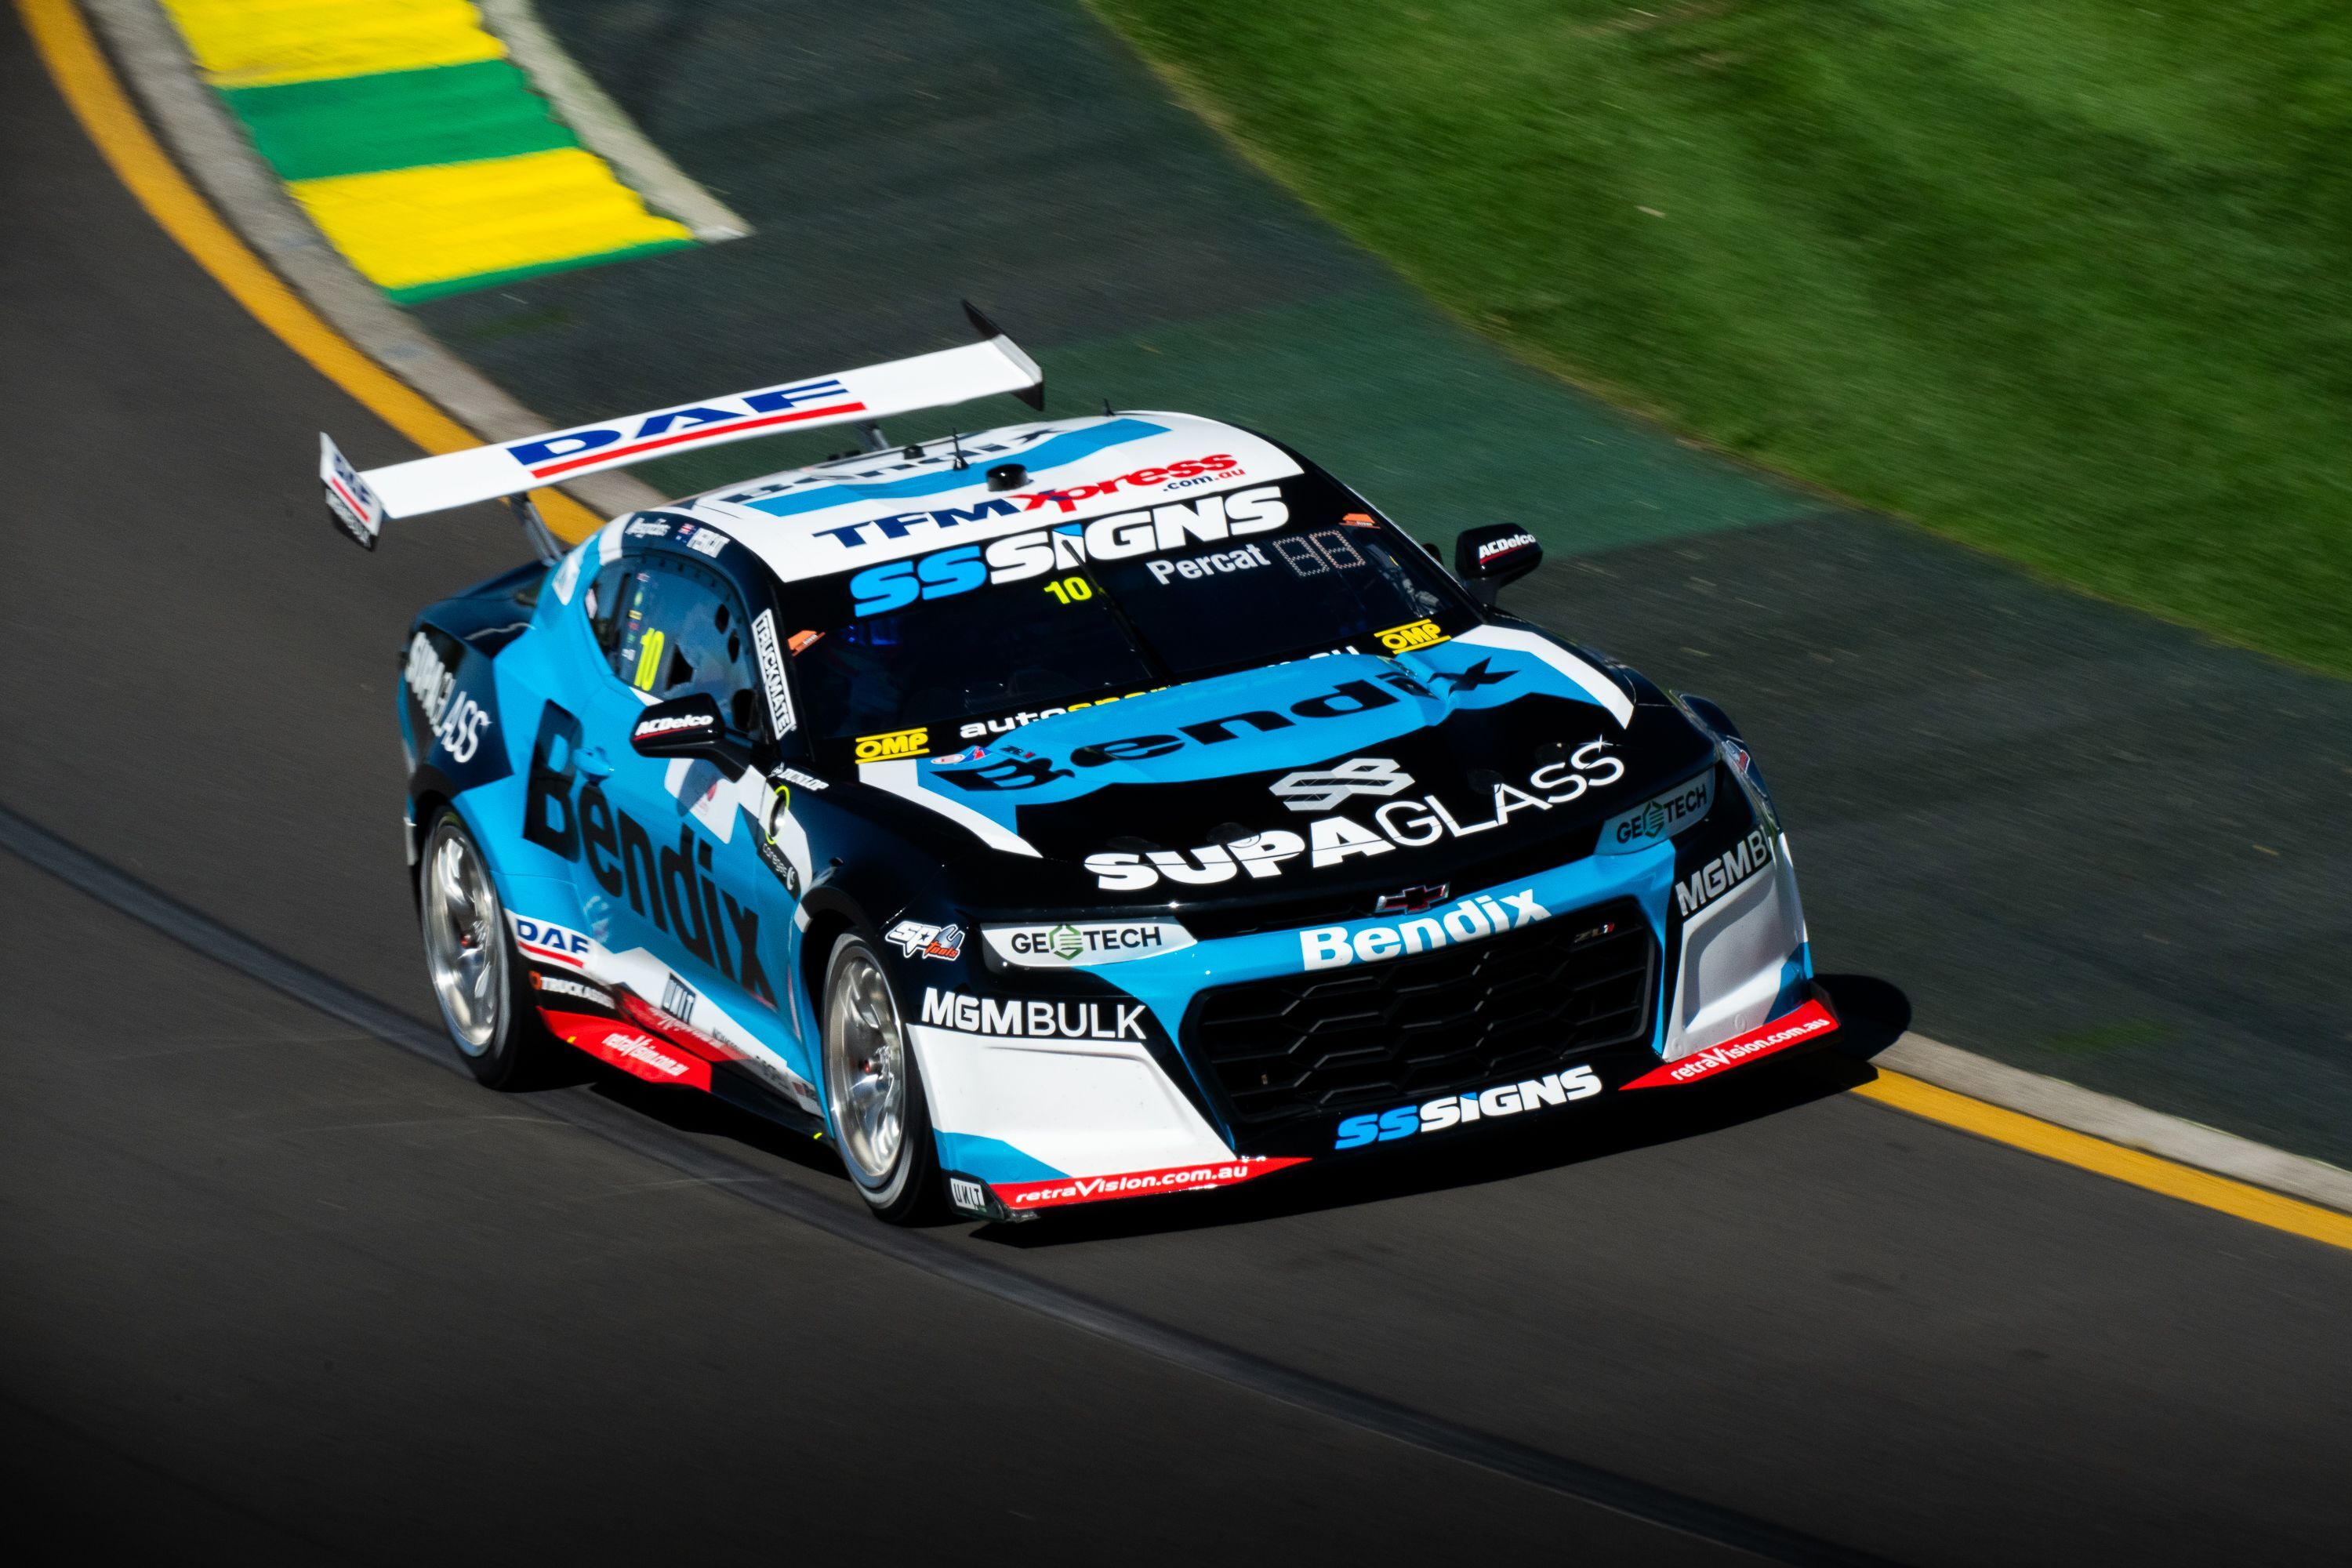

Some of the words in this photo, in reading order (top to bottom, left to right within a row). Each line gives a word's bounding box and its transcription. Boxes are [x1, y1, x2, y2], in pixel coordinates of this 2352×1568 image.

[506, 379, 850, 465] DAF
[812, 453, 1240, 548] TFMXpress
[1162, 465, 1246, 492] .com.au
[1145, 543, 1272, 586] Percat
[1479, 532, 1537, 560] ACDelco
[1044, 575, 1093, 605] 10
[633, 627, 665, 691] 10
[1382, 623, 1442, 651] OMP
[754, 615, 790, 734] TRUCKMATE
[635, 714, 713, 736] ACDelco
[855, 732, 929, 759] OMP
[930, 656, 1520, 791] Bendix
[1083, 740, 1625, 891] SUPAGLASS
[523, 698, 779, 1011] Bendix
[1675, 826, 1769, 916] MGMB
[515, 918, 590, 956] DAF
[924, 940, 959, 959] tools
[1299, 888, 1552, 971] Bendix
[921, 986, 1147, 1040] MGMBULK
[1671, 1017, 1831, 1081] retraVision.com.au
[1015, 1163, 1249, 1203] retraVision.com.au
